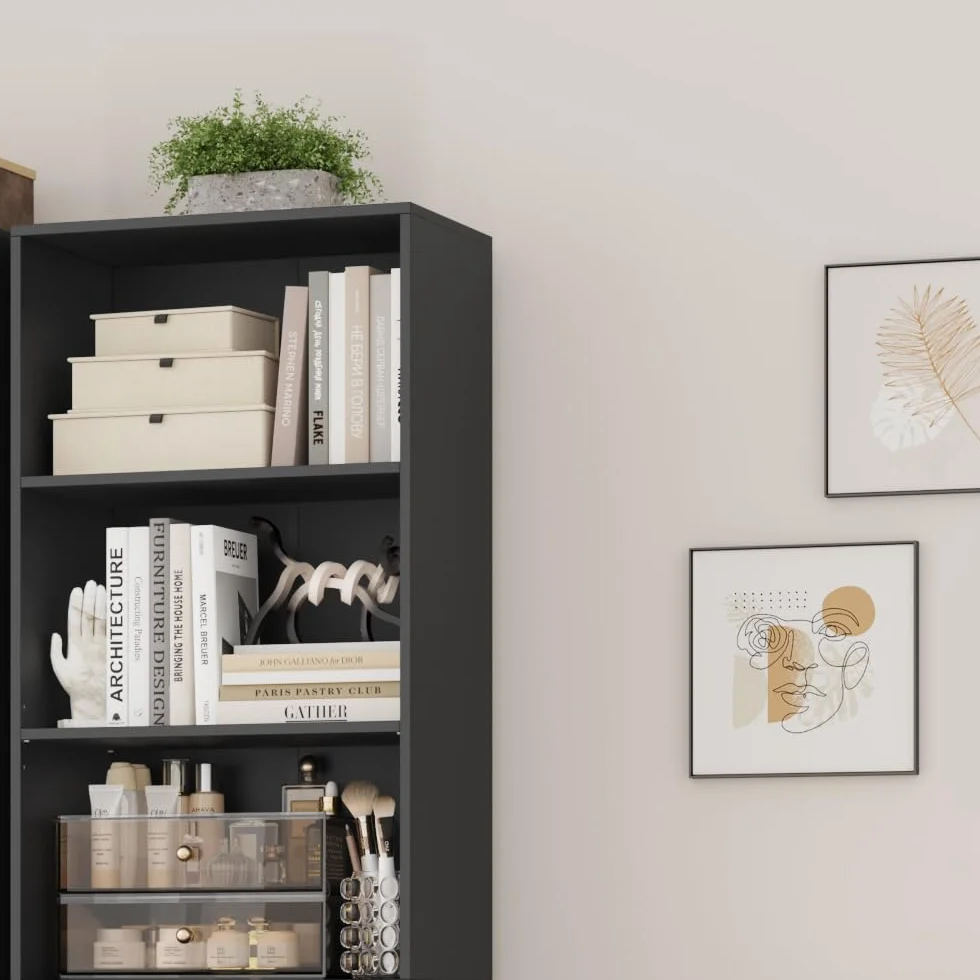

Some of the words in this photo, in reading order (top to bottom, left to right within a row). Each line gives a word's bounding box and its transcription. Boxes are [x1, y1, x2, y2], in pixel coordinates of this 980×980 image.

[351, 325, 364, 342] НЕ
[285, 331, 298, 380] STEPHEN
[351, 344, 364, 376] БЕРИ
[281, 382, 293, 427] MARINO
[351, 390, 364, 439] ГОЛОВУ
[313, 410, 324, 445] FLAKE
[223, 539, 248, 561] BREUER
[153, 522, 165, 643] FURNITURE
[173, 569, 183, 593] HOME
[110, 547, 123, 702] ARCHITECTURE
[173, 595, 183, 622] HOUSE
[200, 594, 208, 628] MARCEL
[173, 623, 183, 640] THE
[200, 631, 208, 665] BREUER
[173, 642, 183, 682] BRINGING
[258, 659, 282, 667] JOHN
[283, 656, 328, 666] GALLIANO
[340, 655, 364, 664] DIOR
[153, 650, 165, 726] DESIGN
[255, 688, 292, 697] PARIS
[296, 687, 343, 697] PASTRY
[348, 686, 382, 695] CLUB
[284, 704, 348, 719] GATHER
